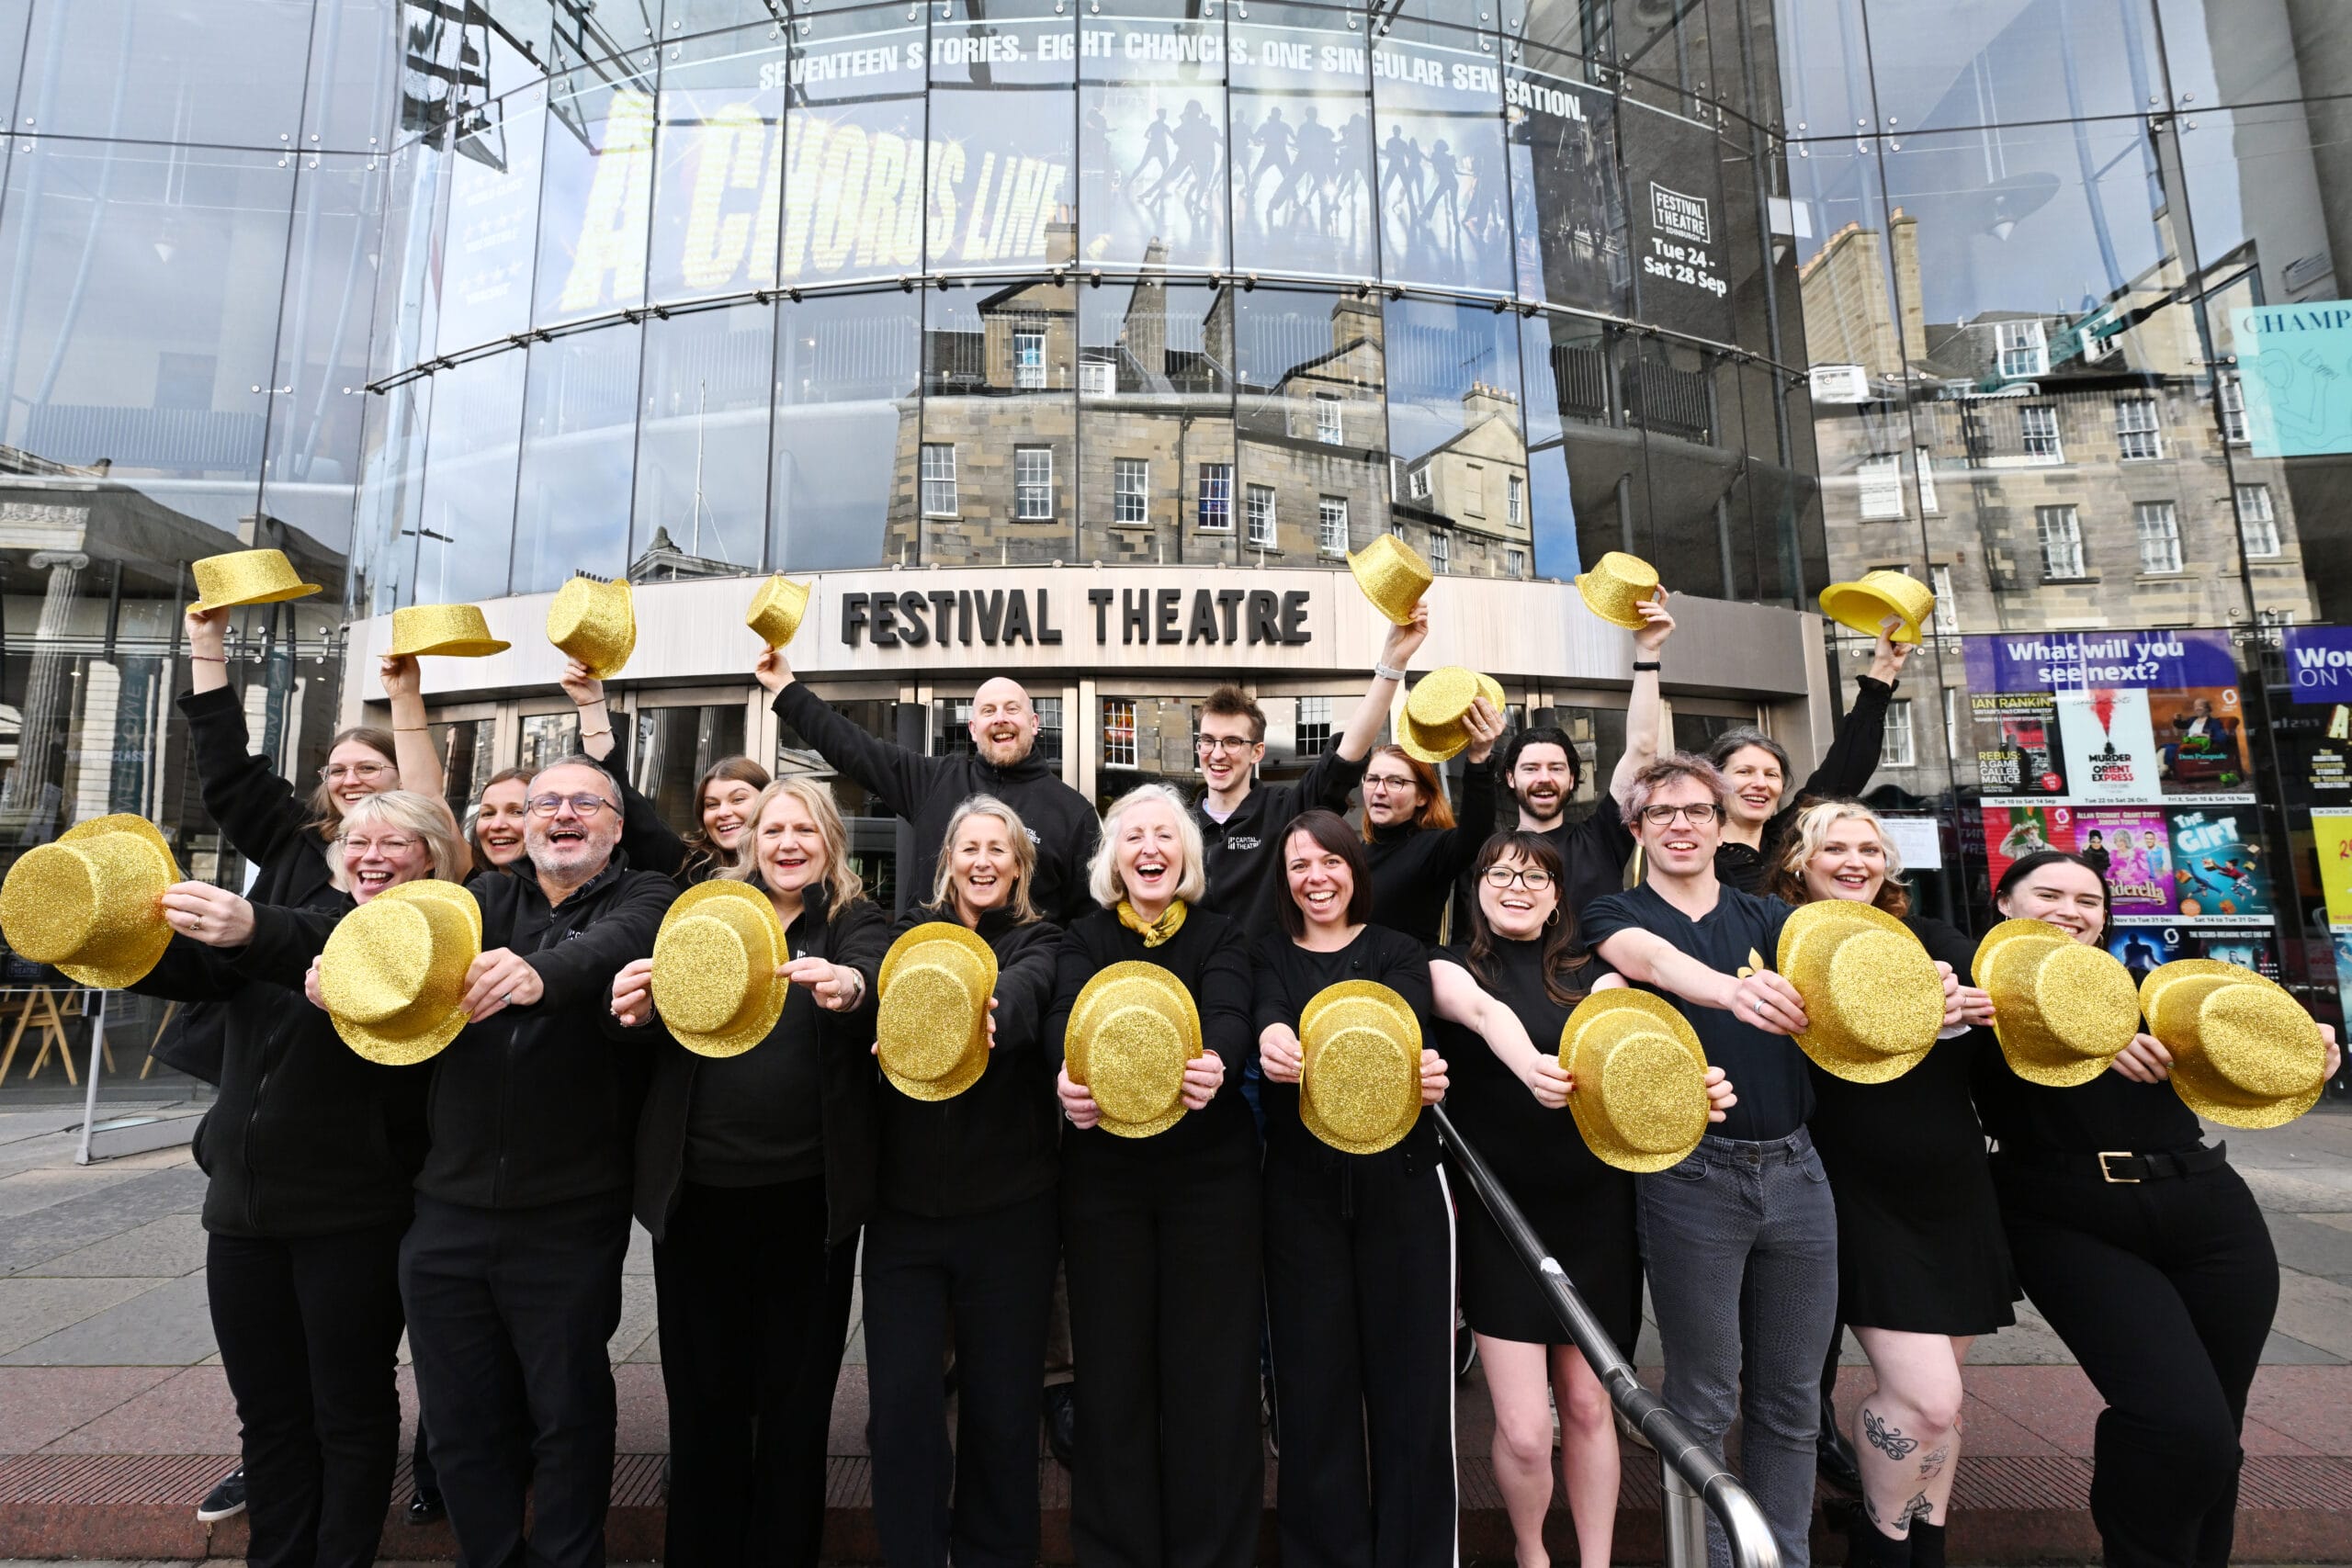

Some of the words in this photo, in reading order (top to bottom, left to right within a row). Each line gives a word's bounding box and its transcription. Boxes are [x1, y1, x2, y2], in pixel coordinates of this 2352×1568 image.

[759, 45, 899, 90] SEVENTEEN
[906, 34, 1028, 70] STORIES.
[1037, 29, 1116, 62] EIGHT
[1262, 39, 1313, 71] ONE
[1320, 46, 1445, 88] SINGULAR
[1451, 62, 1588, 123] SENSATION.
[682, 101, 966, 288] CHORUS
[961, 150, 1067, 261] LINE
[1656, 191, 1705, 220] FESTIVAL
[1657, 208, 1706, 236] THEATRE
[1665, 226, 1701, 243] EDINBURGH
[1652, 237, 1685, 262] Tue
[1687, 247, 1707, 268] 24
[1644, 255, 1674, 279] Sat
[1675, 264, 1696, 285] 28
[1698, 270, 1727, 299] Sep
[841, 588, 1063, 645] FESTIVAL
[1088, 588, 1313, 645] THEATRE
[2007, 641, 2078, 661] What
[2081, 638, 2131, 660] will
[2134, 640, 2186, 663] you
[2038, 667, 2082, 682] see
[2087, 661, 2160, 682] next?
[2298, 669, 2338, 687] ON
[1972, 698, 1996, 709] IAN
[1978, 750, 2021, 761] REBUS:
[1988, 760, 2018, 768] GAME
[2088, 753, 2132, 762] MURDER
[1980, 768, 2021, 776] CALLED
[2092, 773, 2134, 782] EXPRESS
[2093, 765, 2131, 773] ORIENT
[1981, 775, 2021, 784] MALICE
[2173, 811, 2204, 829] THE
[2176, 816, 2240, 853] GIFT
